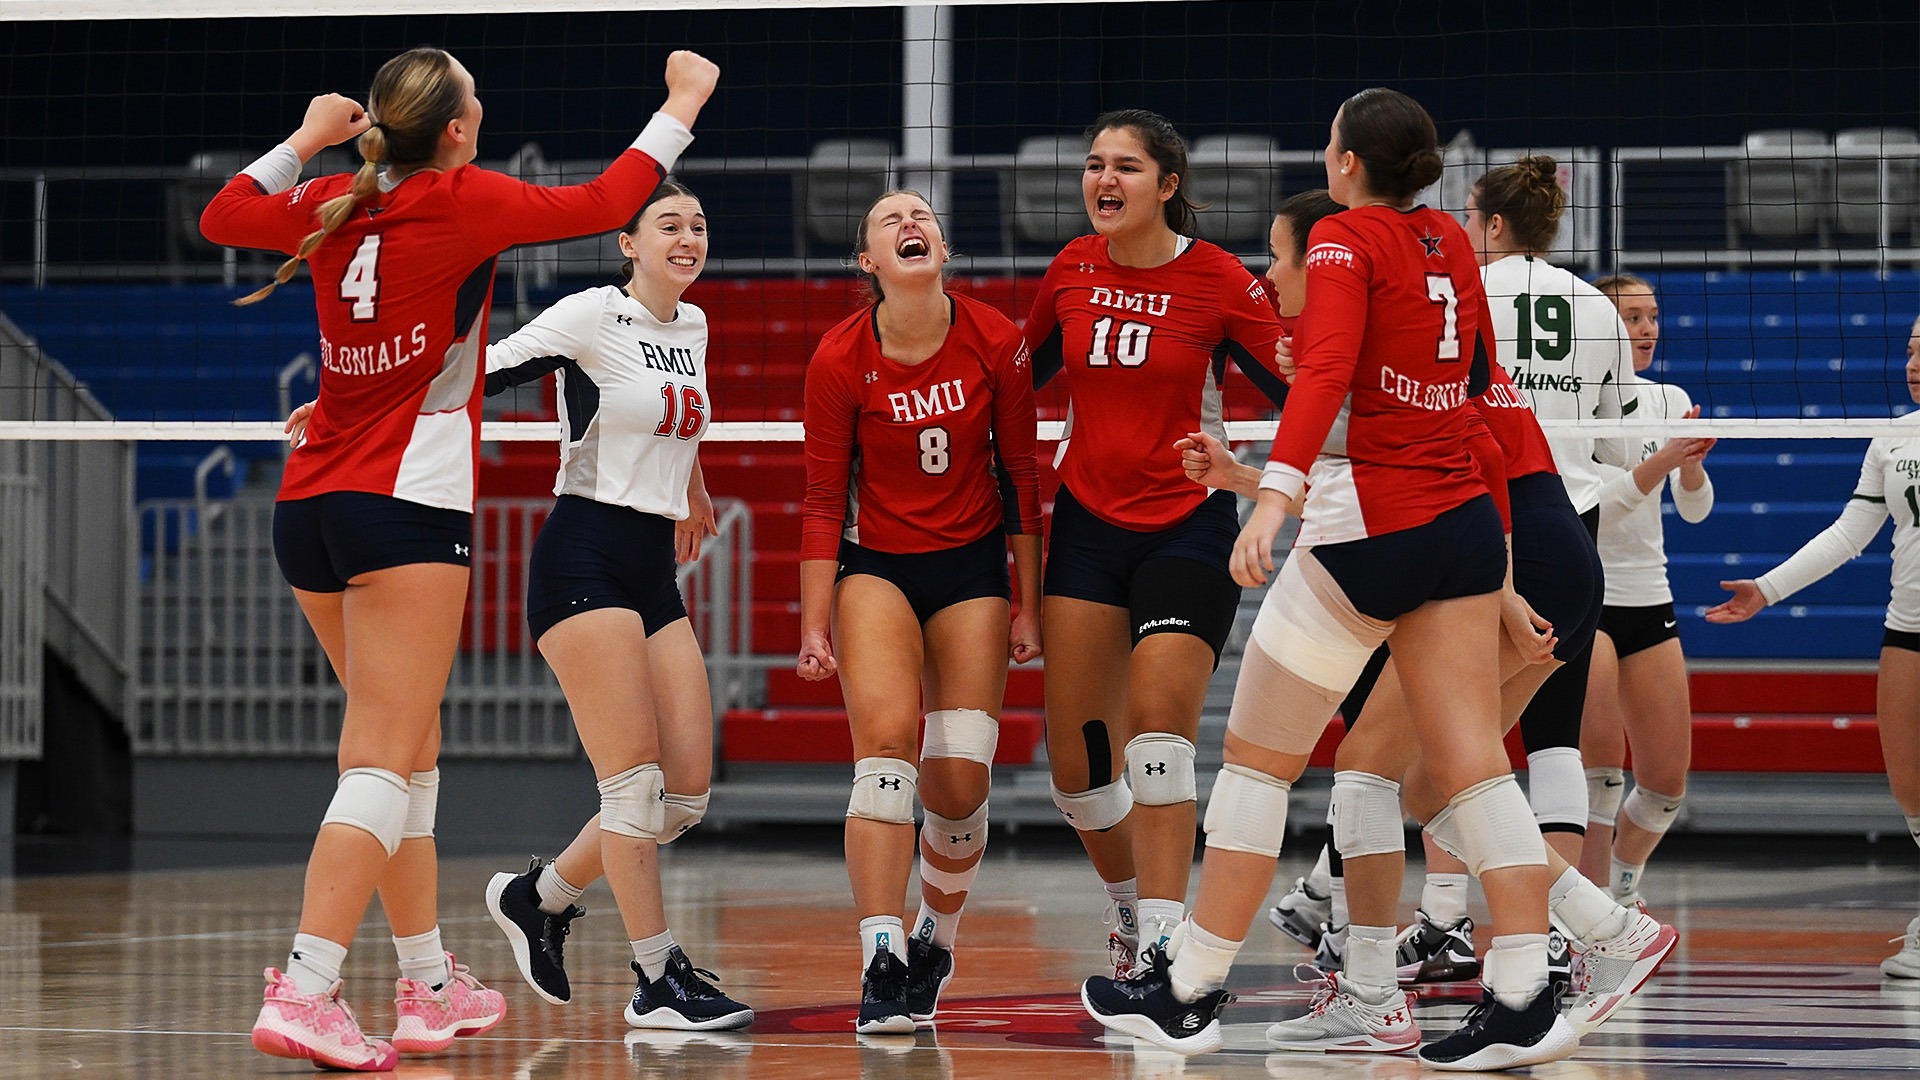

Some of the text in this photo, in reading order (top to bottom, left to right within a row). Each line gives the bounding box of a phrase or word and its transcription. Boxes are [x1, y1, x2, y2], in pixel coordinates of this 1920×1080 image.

[338, 231, 383, 323] 4
[1089, 286, 1171, 317] RMU
[1086, 314, 1156, 369] 10
[1424, 272, 1462, 363] 7
[1514, 292, 1572, 361] 19
[320, 323, 427, 376] OLONIALS
[638, 340, 697, 377] RMU
[653, 381, 705, 441] 16
[887, 379, 966, 422] RMU
[1381, 365, 1470, 411] COLONIA
[916, 425, 952, 476] 8
[1904, 485, 1920, 527] 1
